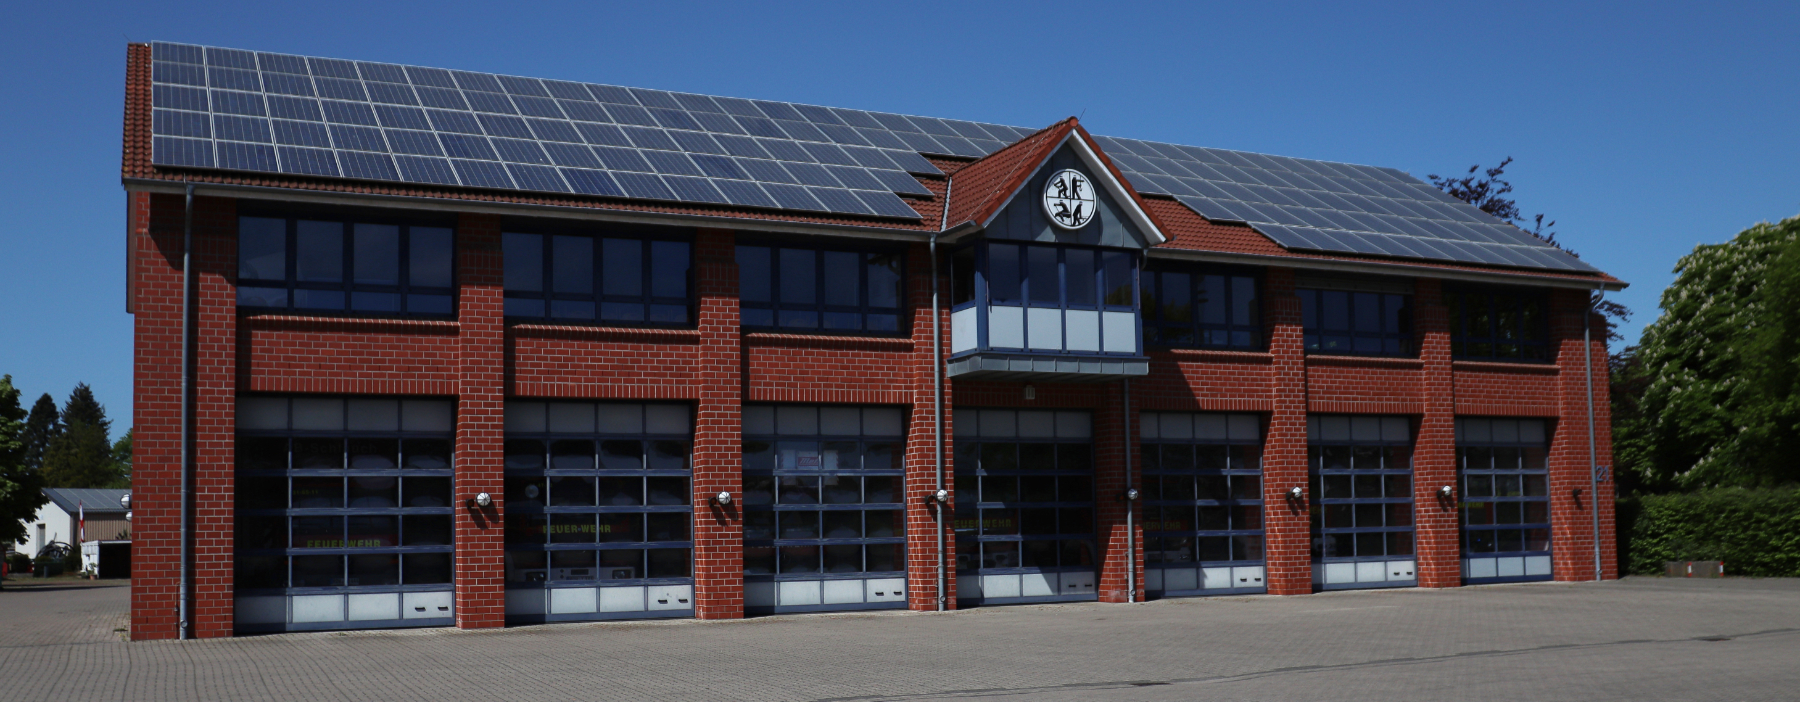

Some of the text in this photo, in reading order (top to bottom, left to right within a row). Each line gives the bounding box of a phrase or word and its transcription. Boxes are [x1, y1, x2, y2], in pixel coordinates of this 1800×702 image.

[1596, 465, 1609, 482] 21
[954, 518, 1012, 529] EUERWEHR
[306, 539, 381, 548] FEUERWEHR
